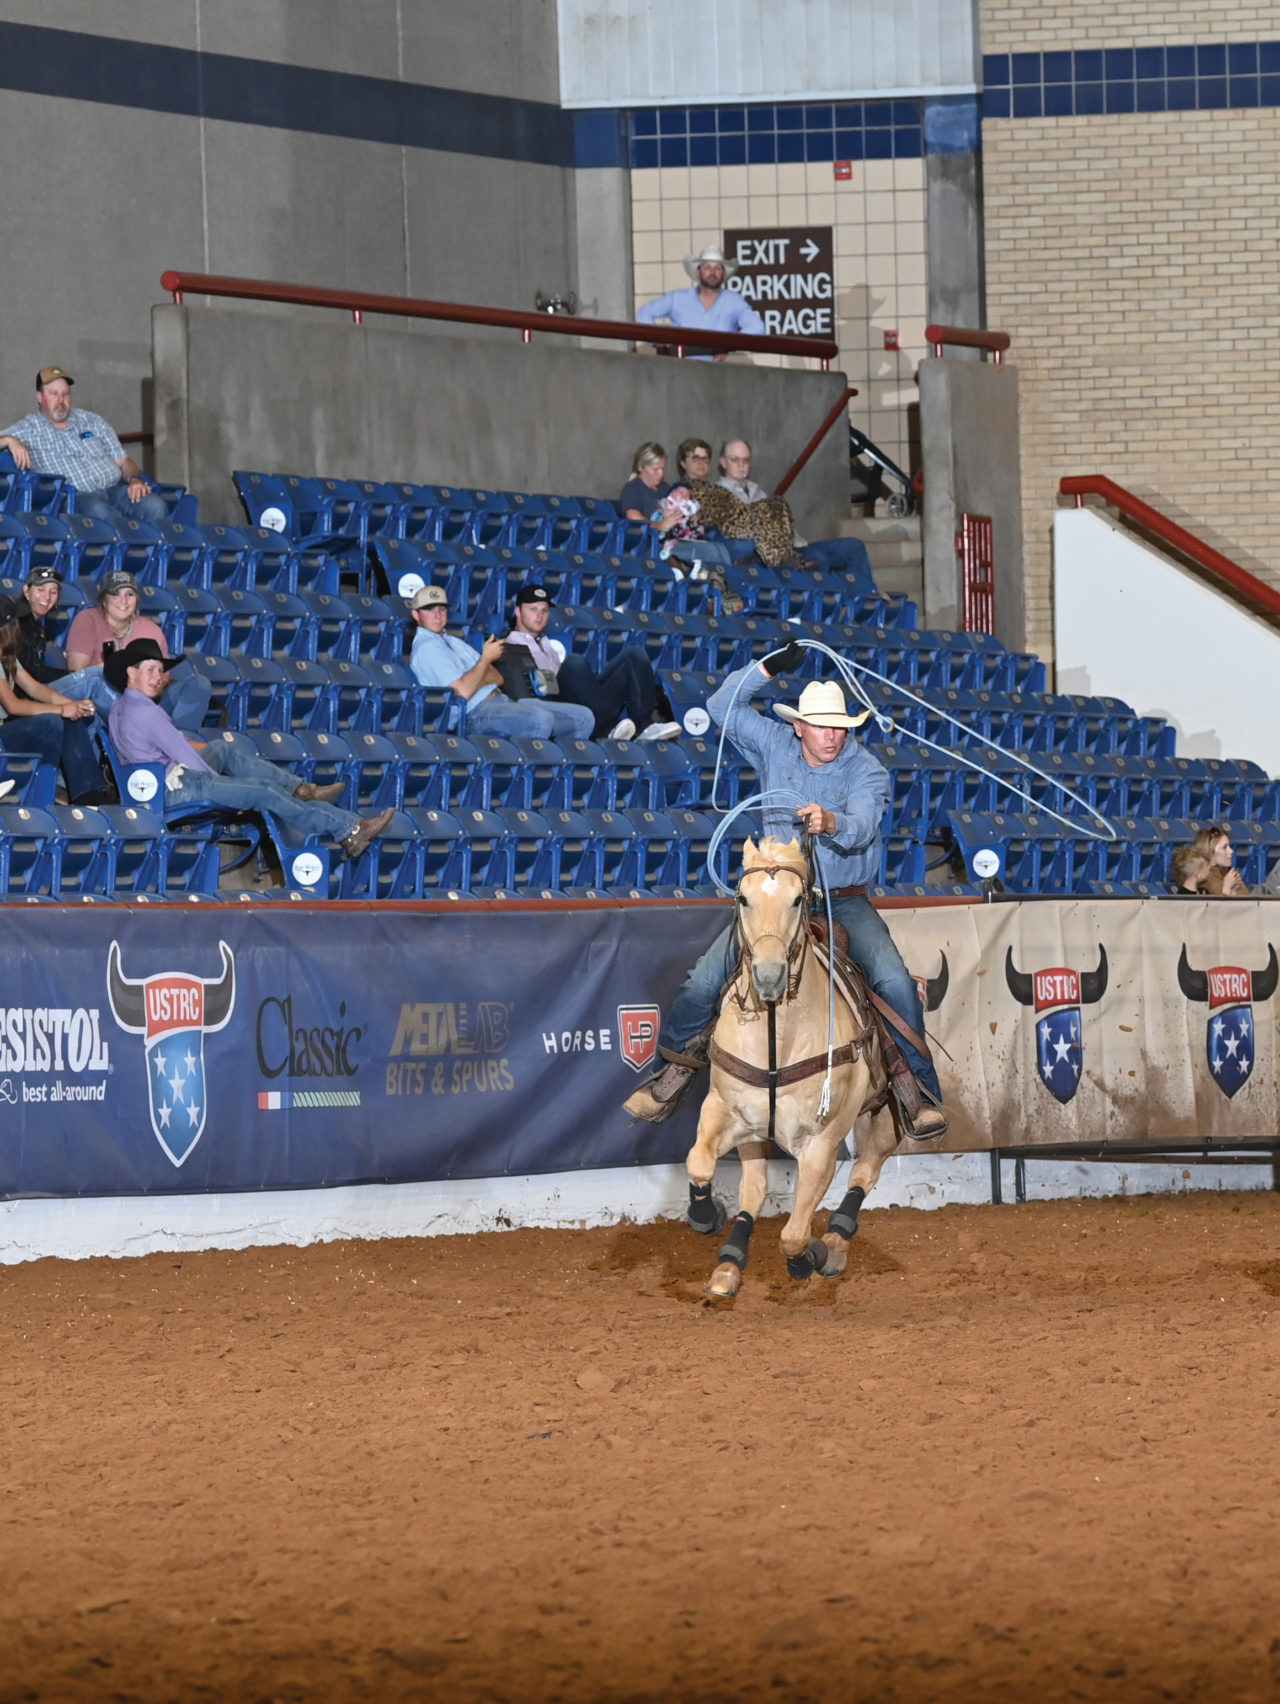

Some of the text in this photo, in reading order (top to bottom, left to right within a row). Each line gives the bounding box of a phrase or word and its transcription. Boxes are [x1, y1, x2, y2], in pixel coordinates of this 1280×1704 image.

[737, 239, 790, 265] EXIT
[727, 272, 832, 300] PARKING
[755, 308, 832, 335] RAGE
[1036, 974, 1077, 1000] USTRC
[1210, 973, 1248, 997] USTRC
[149, 988, 200, 1021] USTRC
[256, 994, 362, 1079] Classic
[542, 1029, 612, 1053] HORSE
[386, 1058, 514, 1095] BITS & SPURS
[22, 1080, 106, 1102] best all-around
